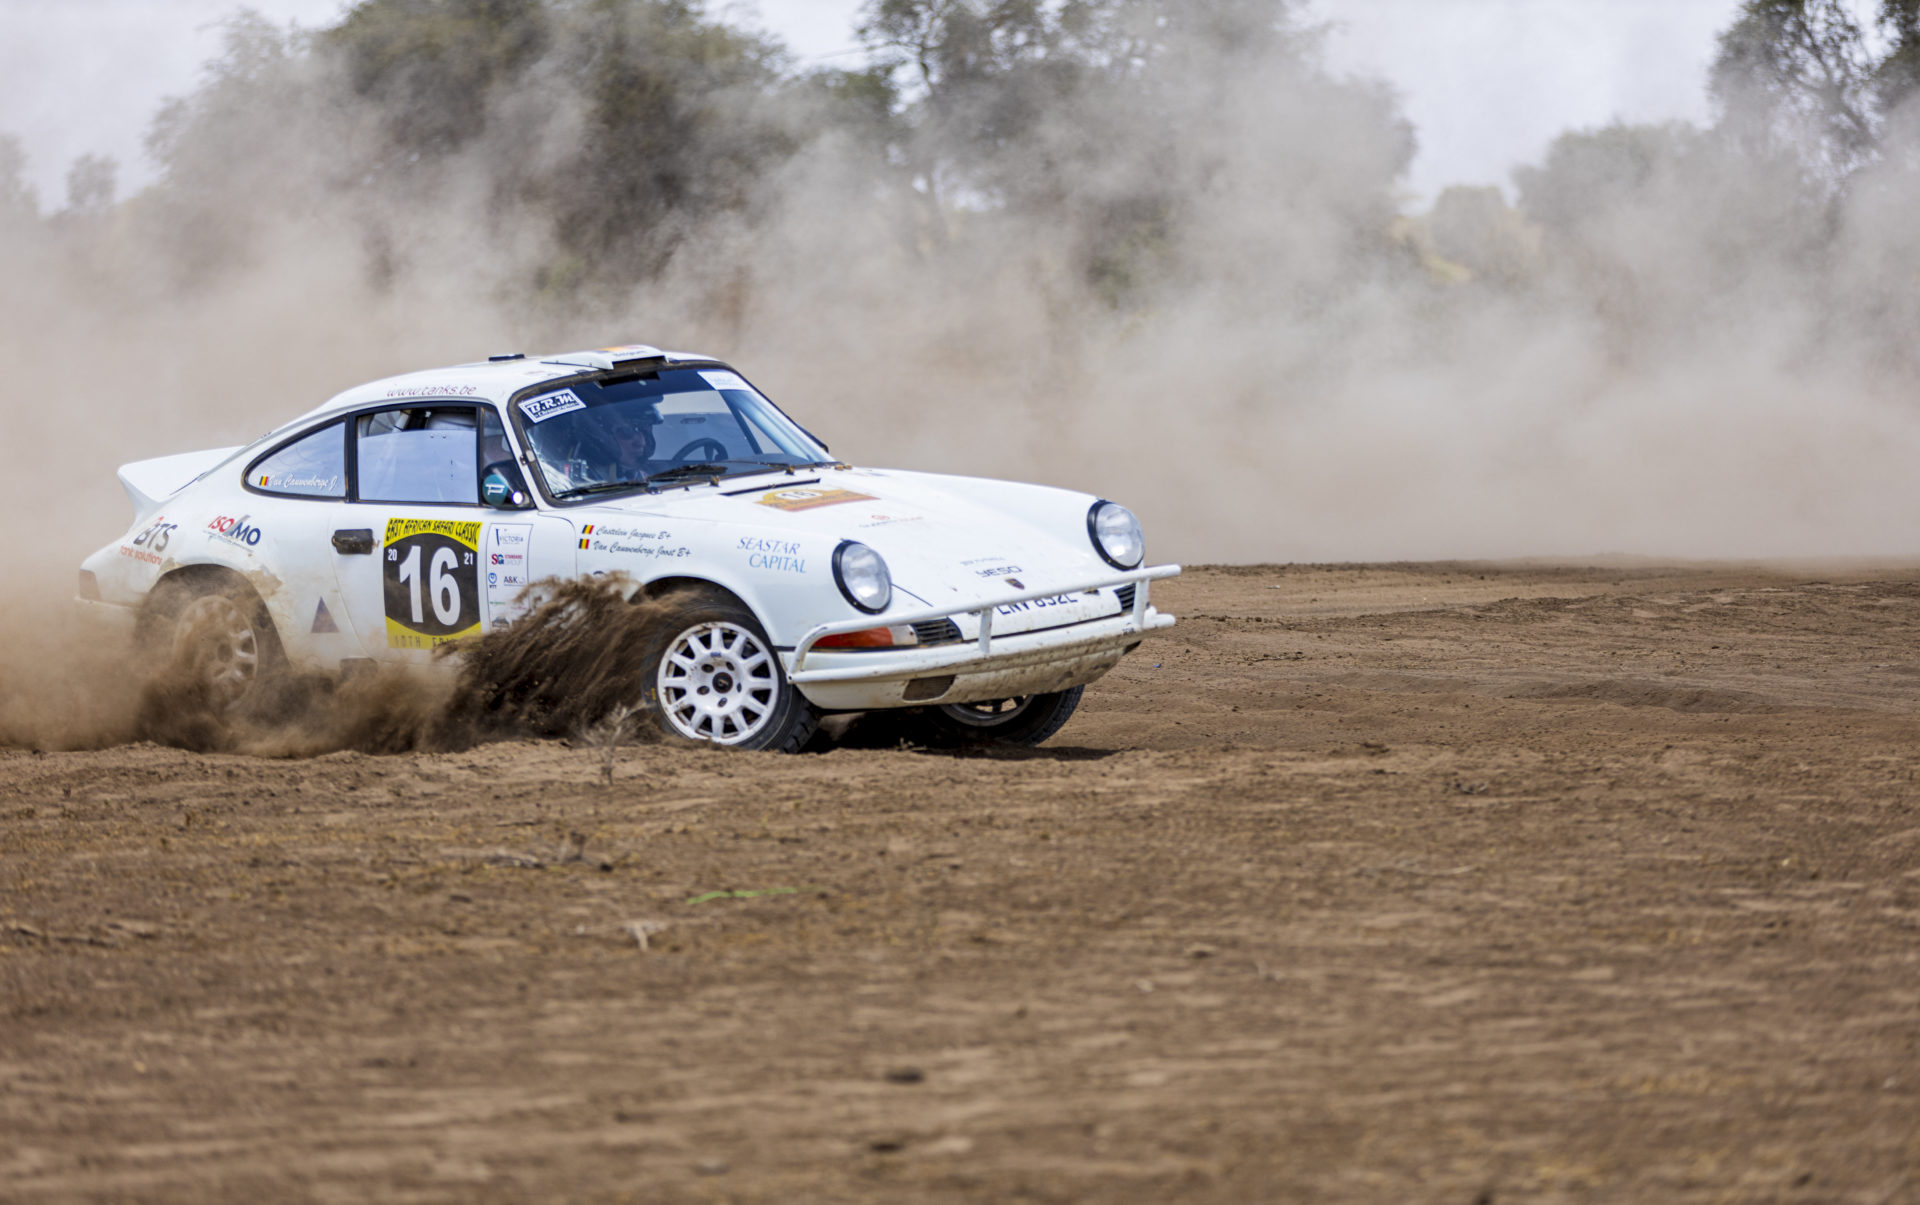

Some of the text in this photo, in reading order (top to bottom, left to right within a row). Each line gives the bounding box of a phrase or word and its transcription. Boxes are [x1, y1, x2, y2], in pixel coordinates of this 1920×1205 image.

[386, 518, 481, 546] EAST AFRICAN SAFARI CLASSIC
[387, 548, 398, 561] 20
[737, 536, 801, 556] SEASTAR
[463, 552, 474, 565] 21
[749, 553, 807, 574] CAPITAL
[399, 545, 461, 626] 16
